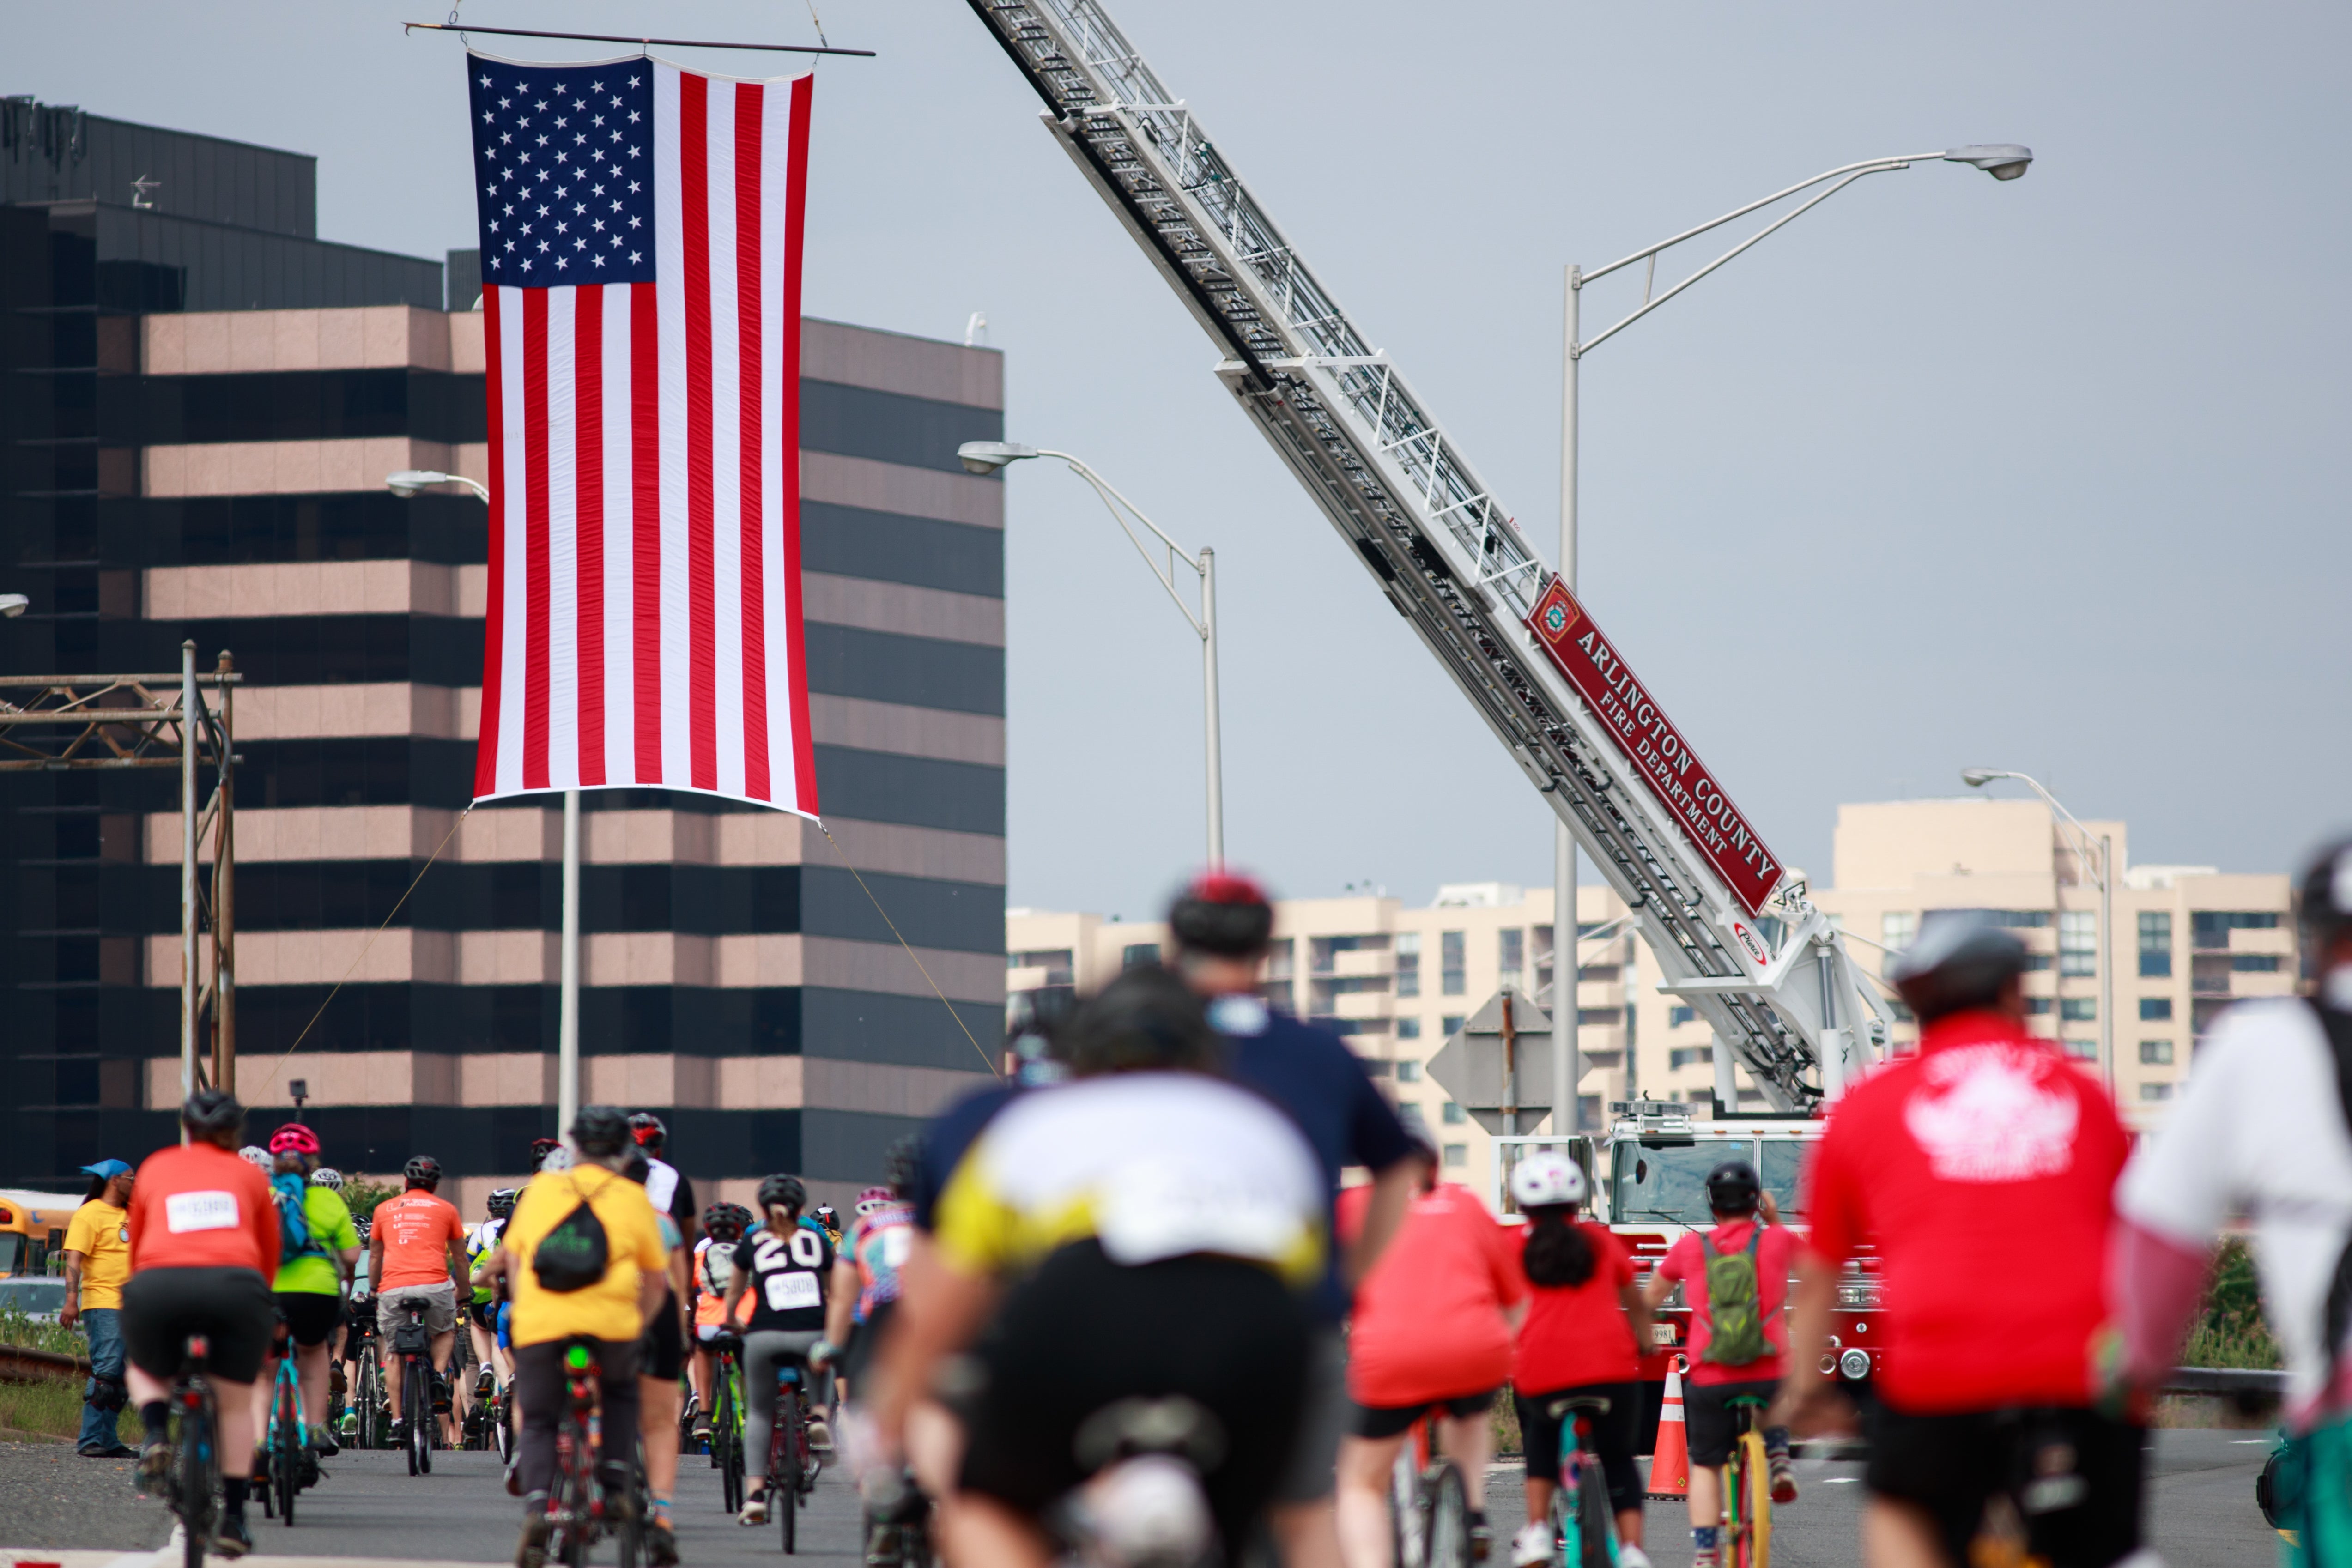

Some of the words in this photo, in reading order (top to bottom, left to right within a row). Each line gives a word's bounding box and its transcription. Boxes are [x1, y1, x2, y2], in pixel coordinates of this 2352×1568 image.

[1553, 587, 1578, 617] ARLINGTON
[1576, 631, 1693, 776] ARLINGTON
[1694, 778, 1775, 880] COUNTY
[1600, 690, 1636, 737] FIRE
[1636, 737, 1727, 854] DEPARTMENT
[1740, 932, 1760, 957] Pierce
[752, 1229, 824, 1274] 20
